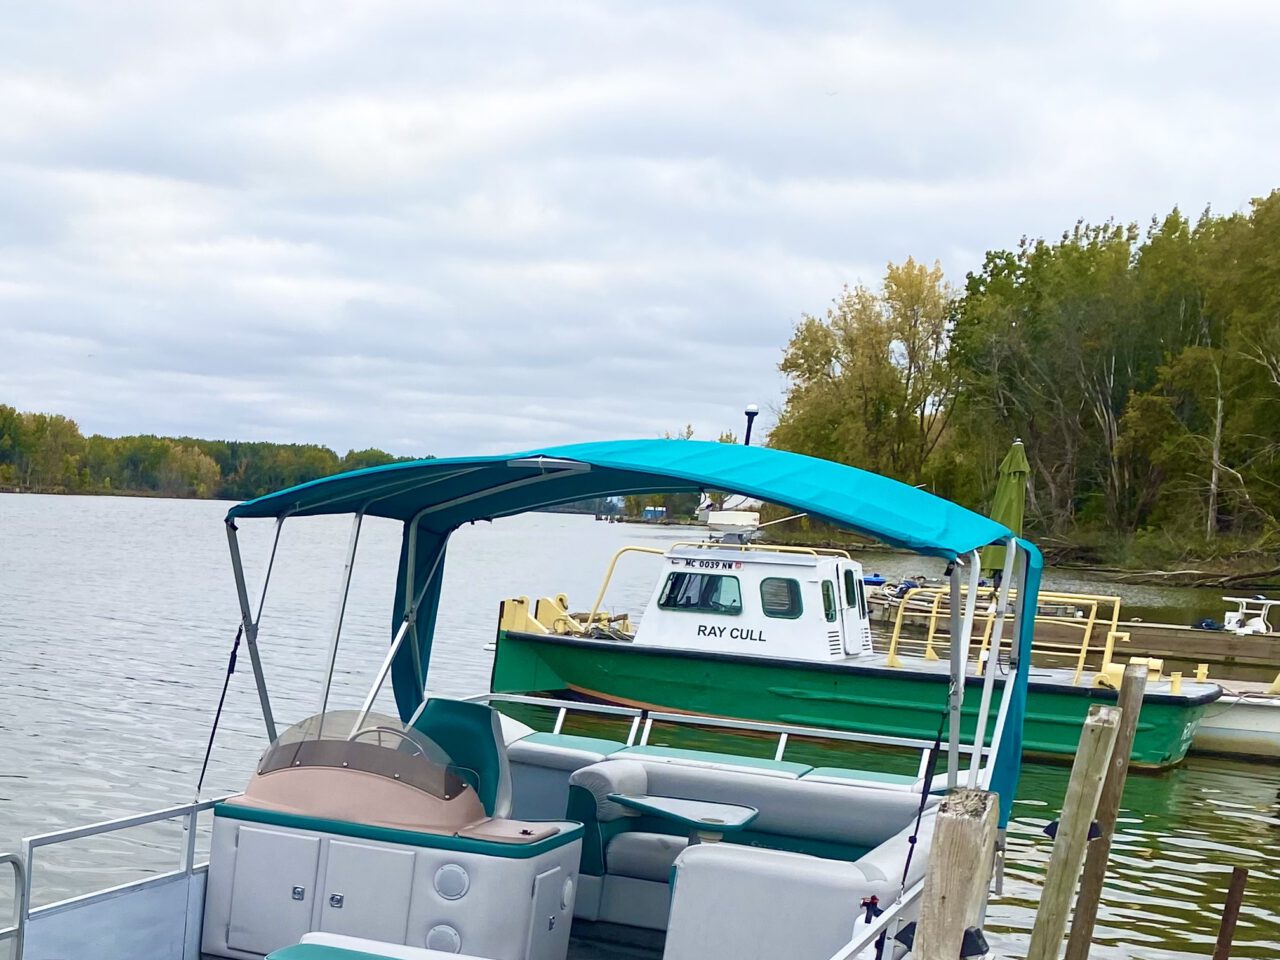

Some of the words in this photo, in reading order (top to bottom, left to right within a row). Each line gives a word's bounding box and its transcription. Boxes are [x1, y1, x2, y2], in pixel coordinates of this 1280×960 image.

[699, 560, 720, 569] 0039
[697, 624, 727, 638] RAY
[729, 627, 767, 642] CULL
